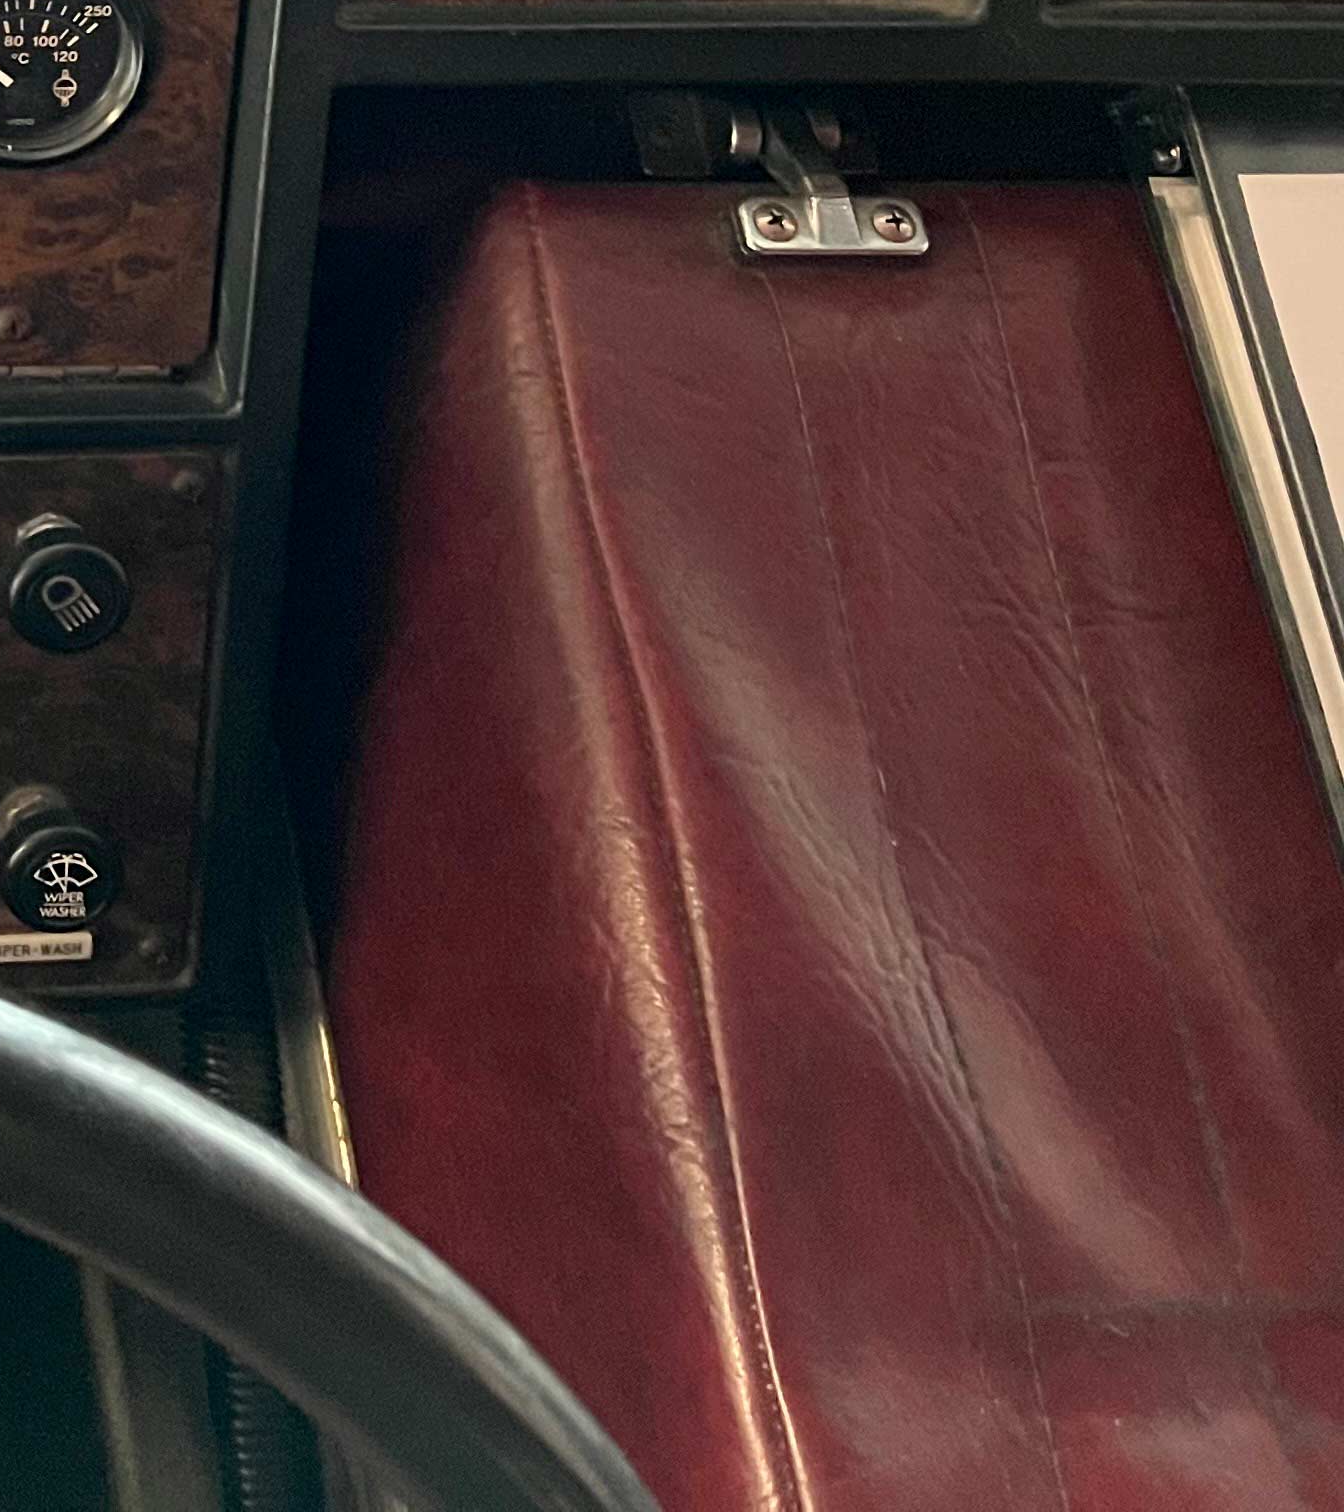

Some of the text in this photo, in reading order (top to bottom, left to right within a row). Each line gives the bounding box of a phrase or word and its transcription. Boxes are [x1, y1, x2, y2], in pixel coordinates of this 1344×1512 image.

[84, 5, 112, 17] 250
[4, 35, 24, 48] 80
[33, 36, 59, 48] 100
[53, 51, 78, 63] 120
[44, 892, 84, 902] WIPER
[39, 907, 86, 917] WASHER
